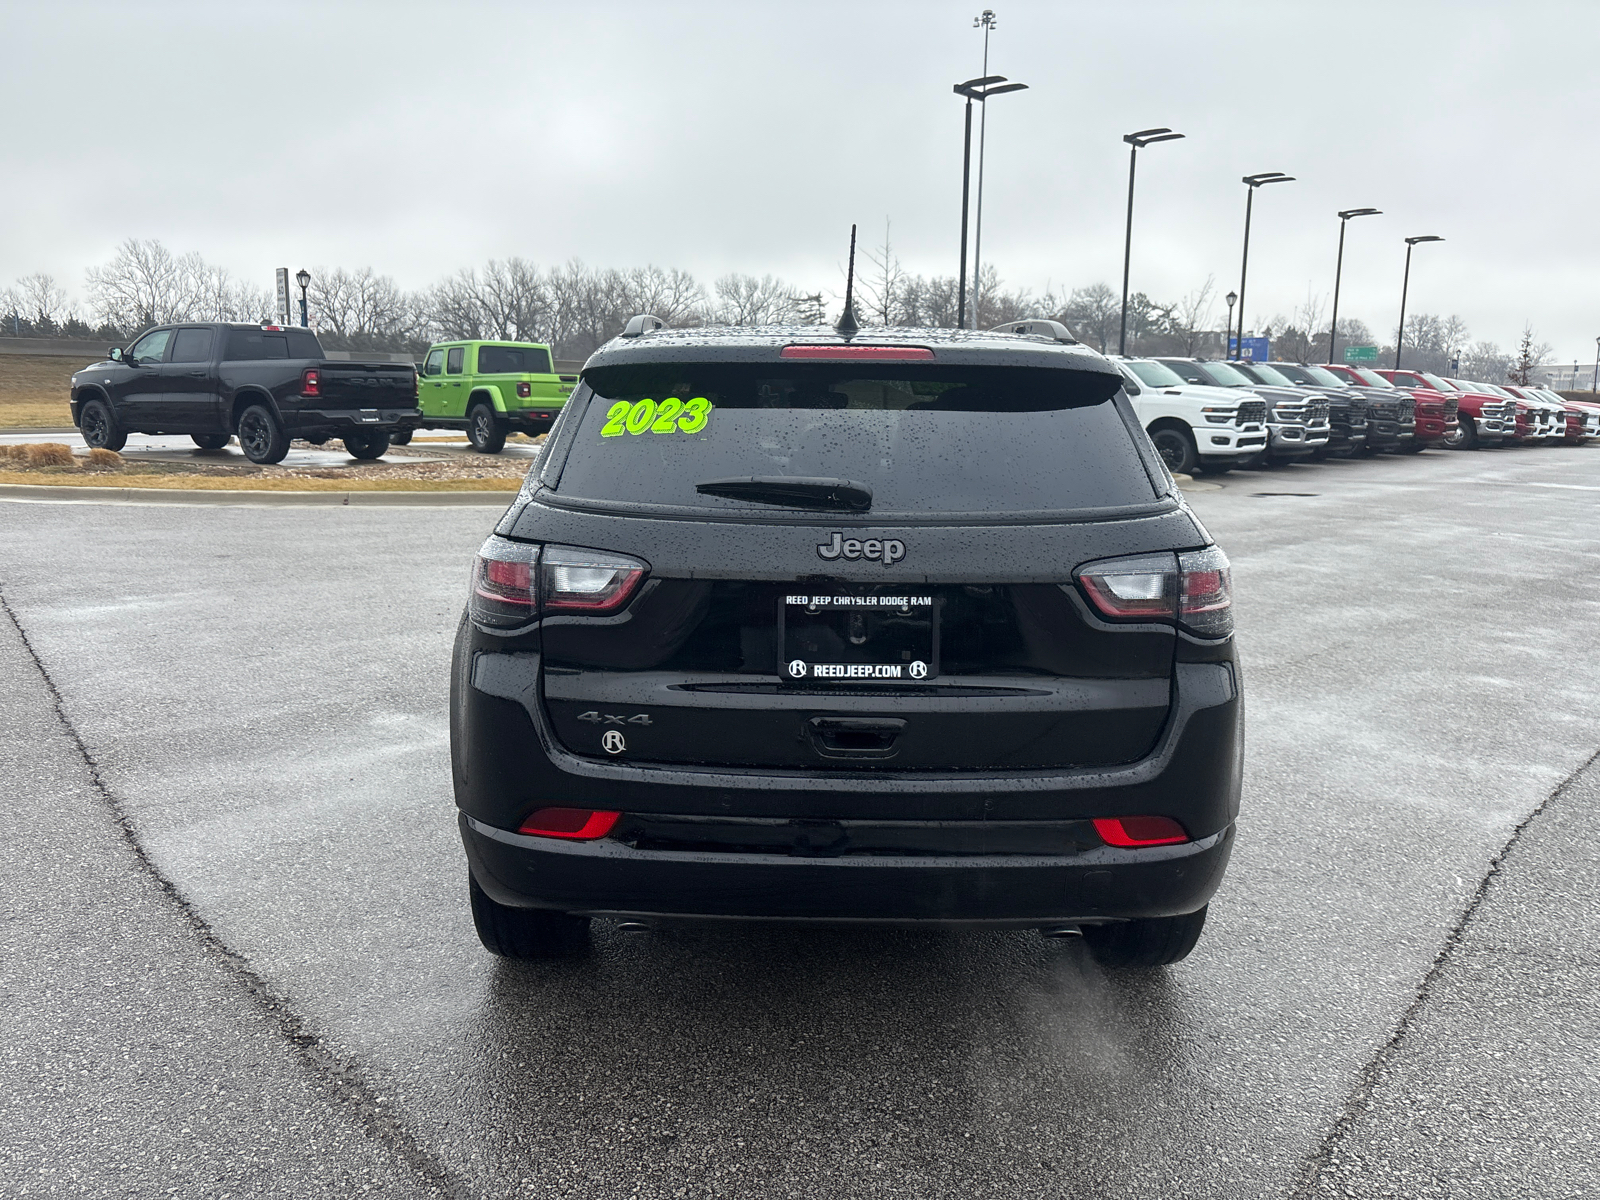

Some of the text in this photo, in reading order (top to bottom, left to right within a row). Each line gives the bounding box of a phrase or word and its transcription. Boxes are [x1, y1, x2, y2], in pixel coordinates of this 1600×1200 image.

[600, 397, 713, 438] 2023
[816, 532, 907, 569] Jeep
[786, 595, 932, 606] REED JEEP CHRYSLER DODGE RAM
[813, 664, 902, 678] REEDJEEP.COM
